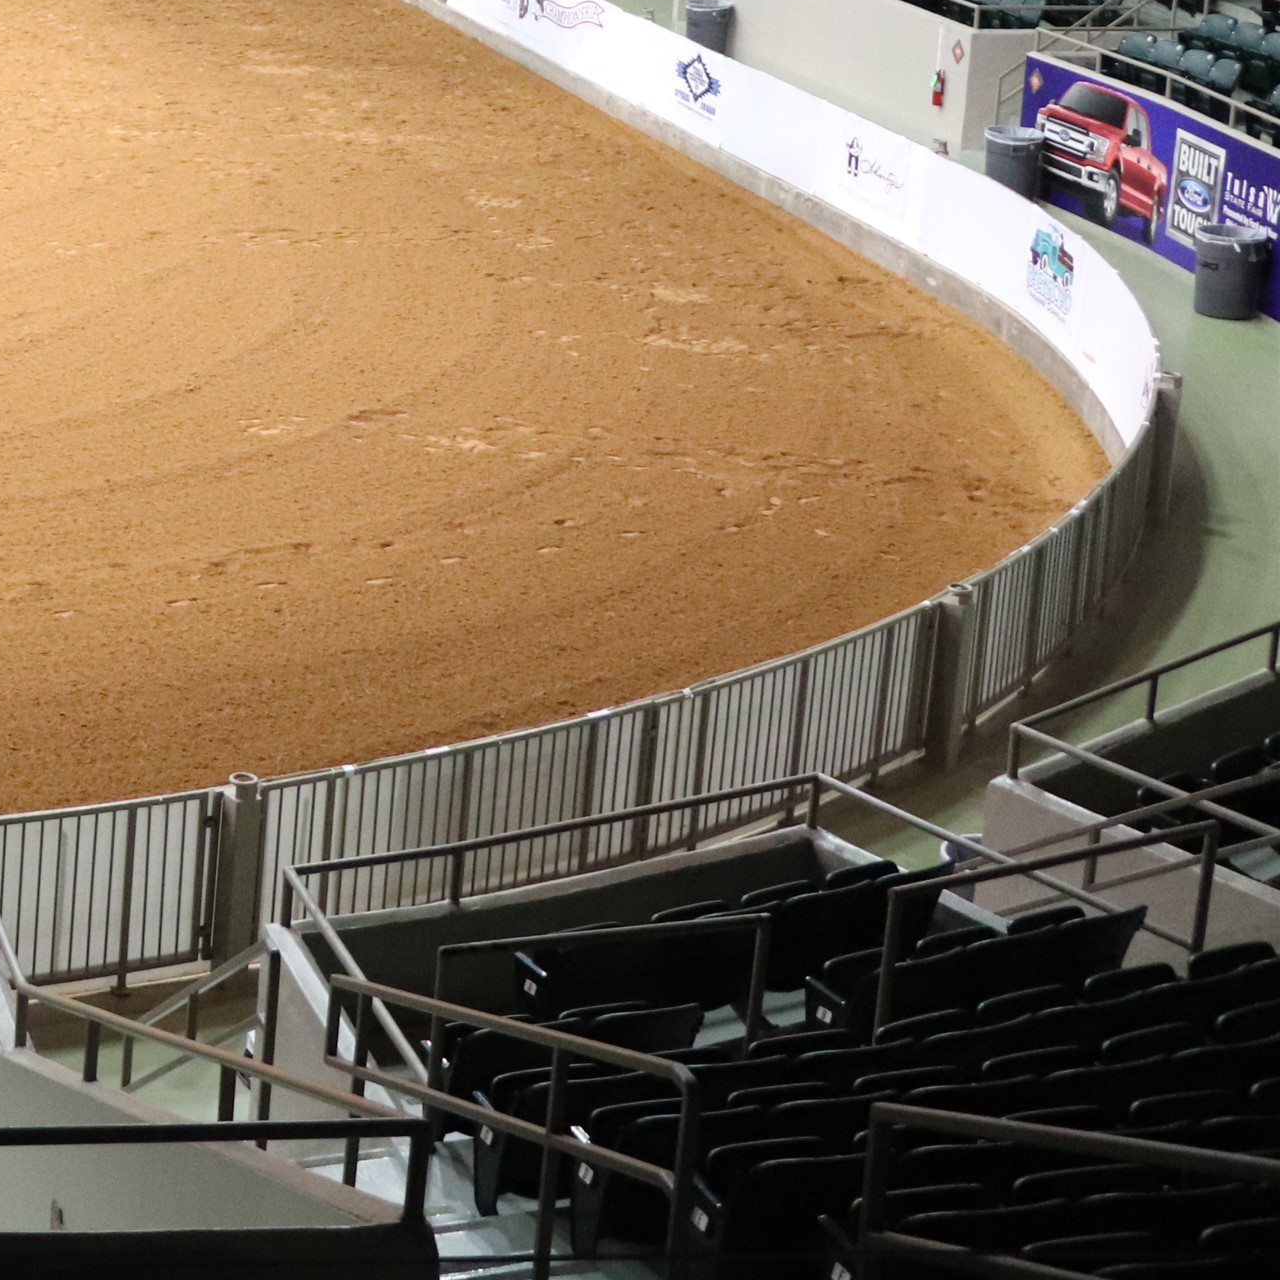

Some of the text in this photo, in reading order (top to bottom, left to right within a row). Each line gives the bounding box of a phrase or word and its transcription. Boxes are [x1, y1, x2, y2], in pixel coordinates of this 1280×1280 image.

[545, 2, 598, 24] CHAMPIONSHIP
[1178, 143, 1219, 186] BUILT
[1184, 185, 1205, 206] Ford
[1226, 171, 1265, 208] Tulsa
[1224, 191, 1245, 210] STATE
[1247, 202, 1264, 218] FAIR
[1172, 204, 1211, 235] TOU
